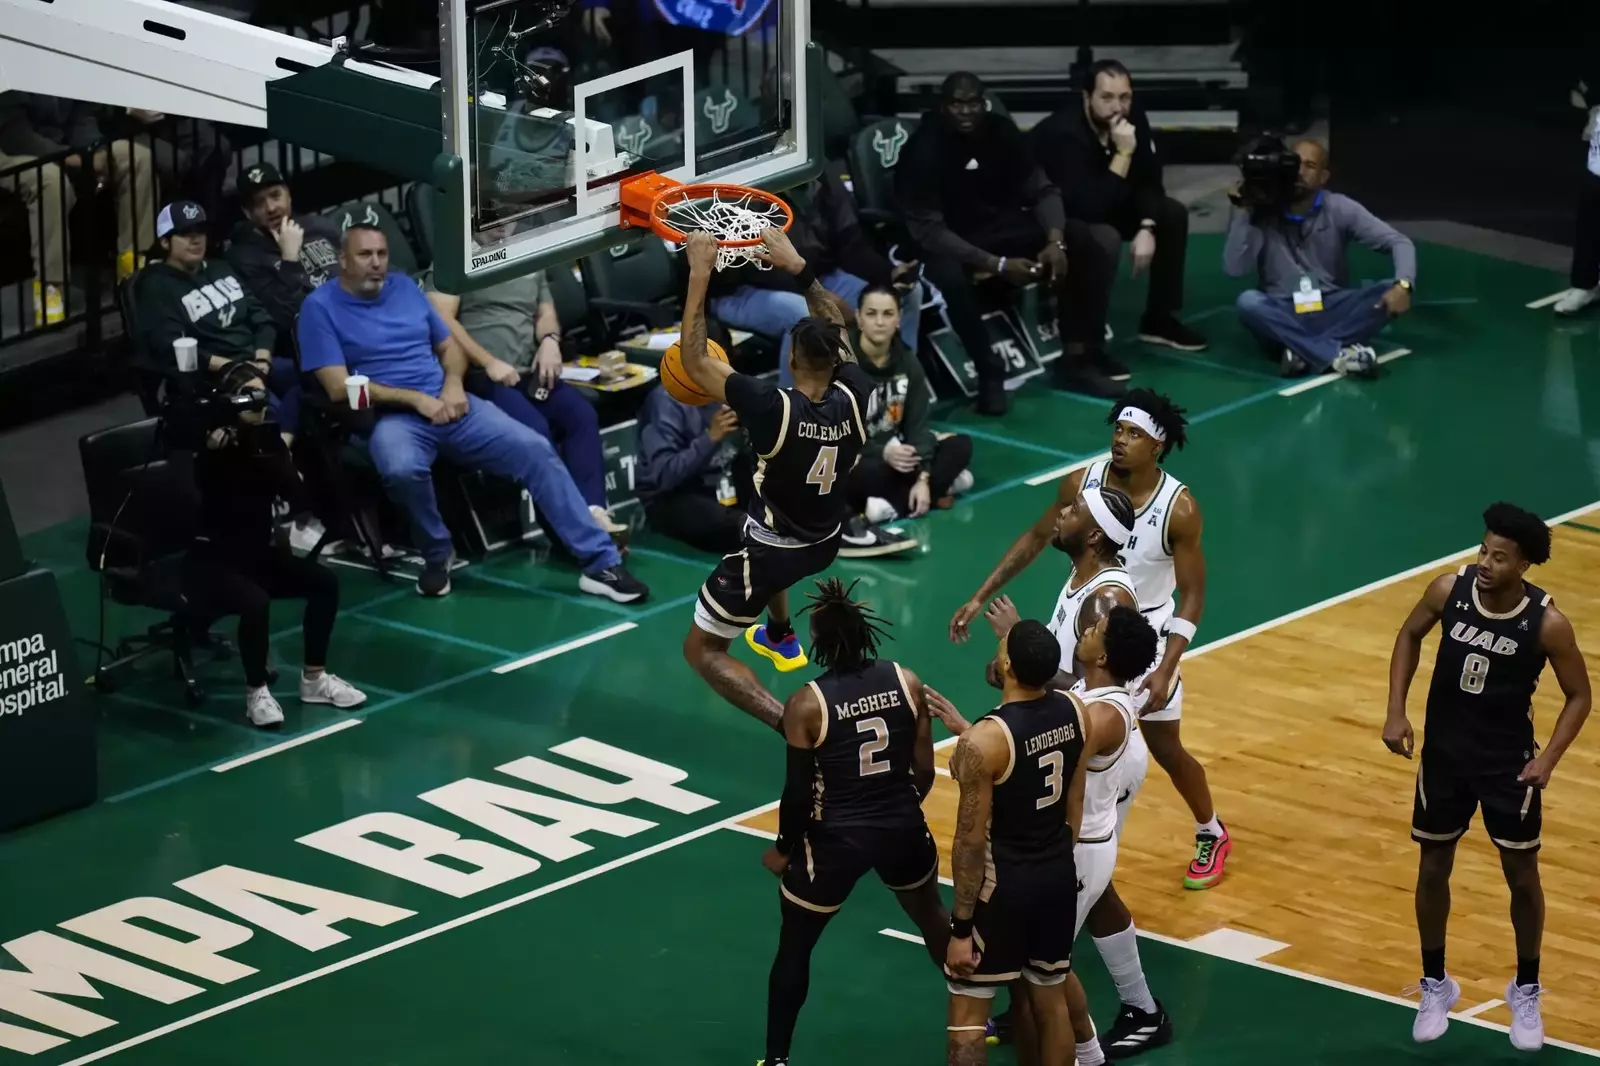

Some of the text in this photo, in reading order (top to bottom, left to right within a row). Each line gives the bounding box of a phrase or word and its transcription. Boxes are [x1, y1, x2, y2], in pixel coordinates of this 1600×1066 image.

[472, 248, 506, 270] SPALDING
[991, 339, 1025, 373] 75
[798, 419, 852, 442] COLEMAN
[805, 445, 839, 496] 4
[1449, 621, 1520, 656] UAB
[0, 649, 58, 690] neral
[1459, 652, 1491, 695] 8
[834, 689, 902, 721] McGHEE
[855, 716, 892, 777] 2
[1024, 722, 1076, 757] LENDEBORG
[1036, 750, 1064, 811] 3
[0, 736, 721, 1056] MPA BAY
